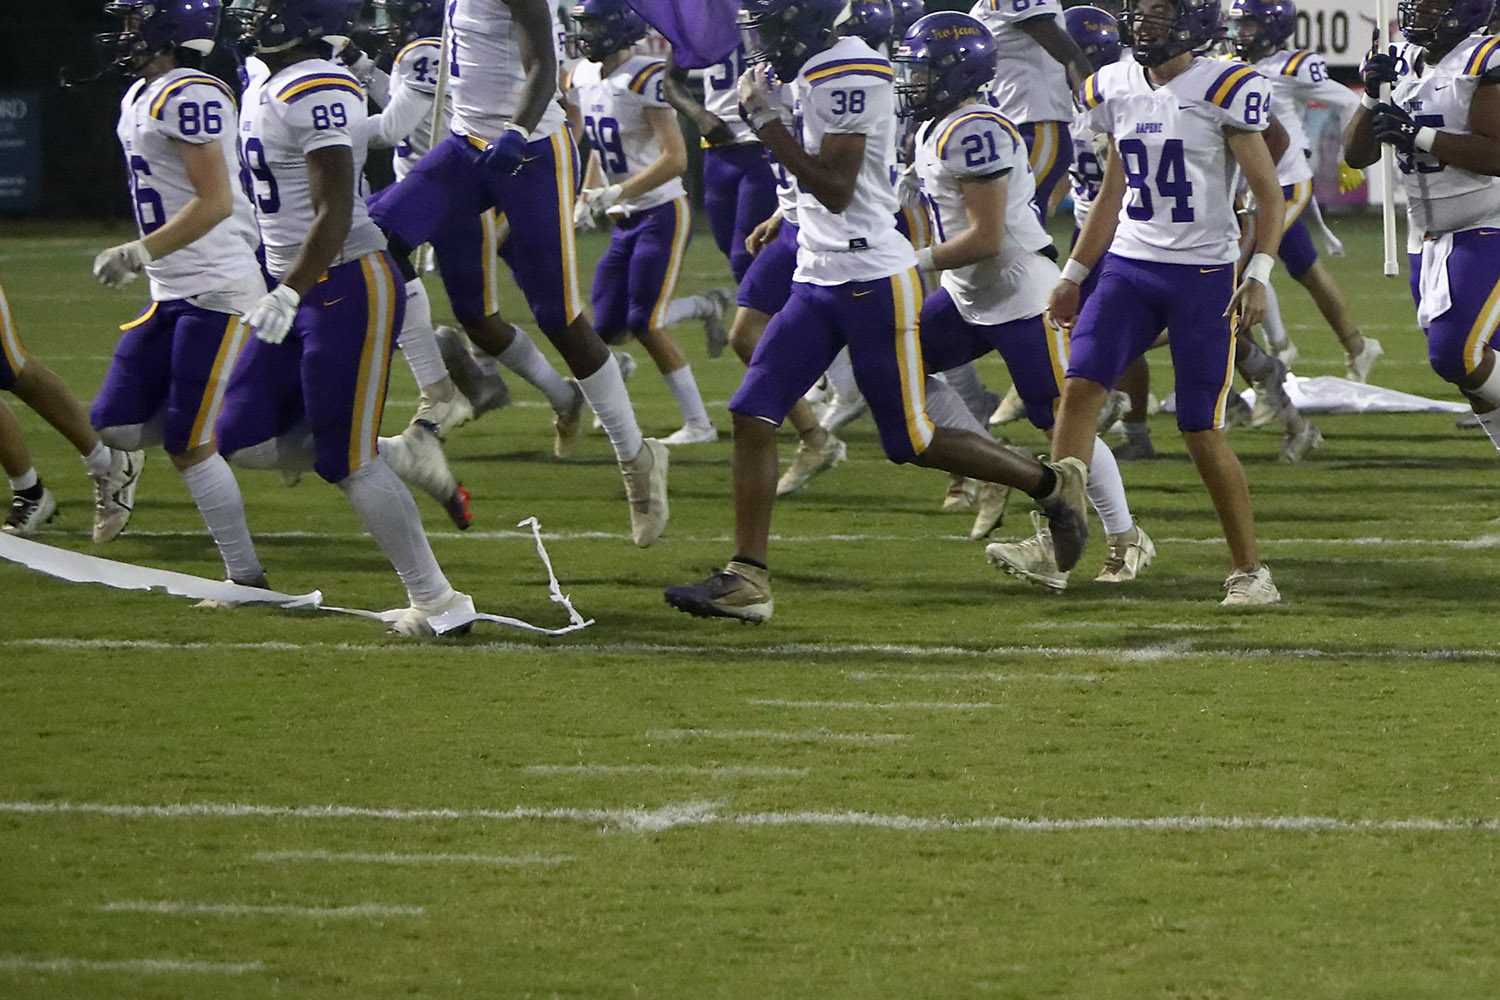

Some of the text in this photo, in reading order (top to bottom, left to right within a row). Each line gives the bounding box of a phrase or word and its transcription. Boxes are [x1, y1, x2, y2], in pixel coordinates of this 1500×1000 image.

[1290, 9, 1349, 54] 010
[178, 100, 223, 136] 86
[312, 102, 348, 131] 89
[831, 89, 866, 115] 38
[961, 130, 1001, 168] 21
[1119, 138, 1195, 223] 84
